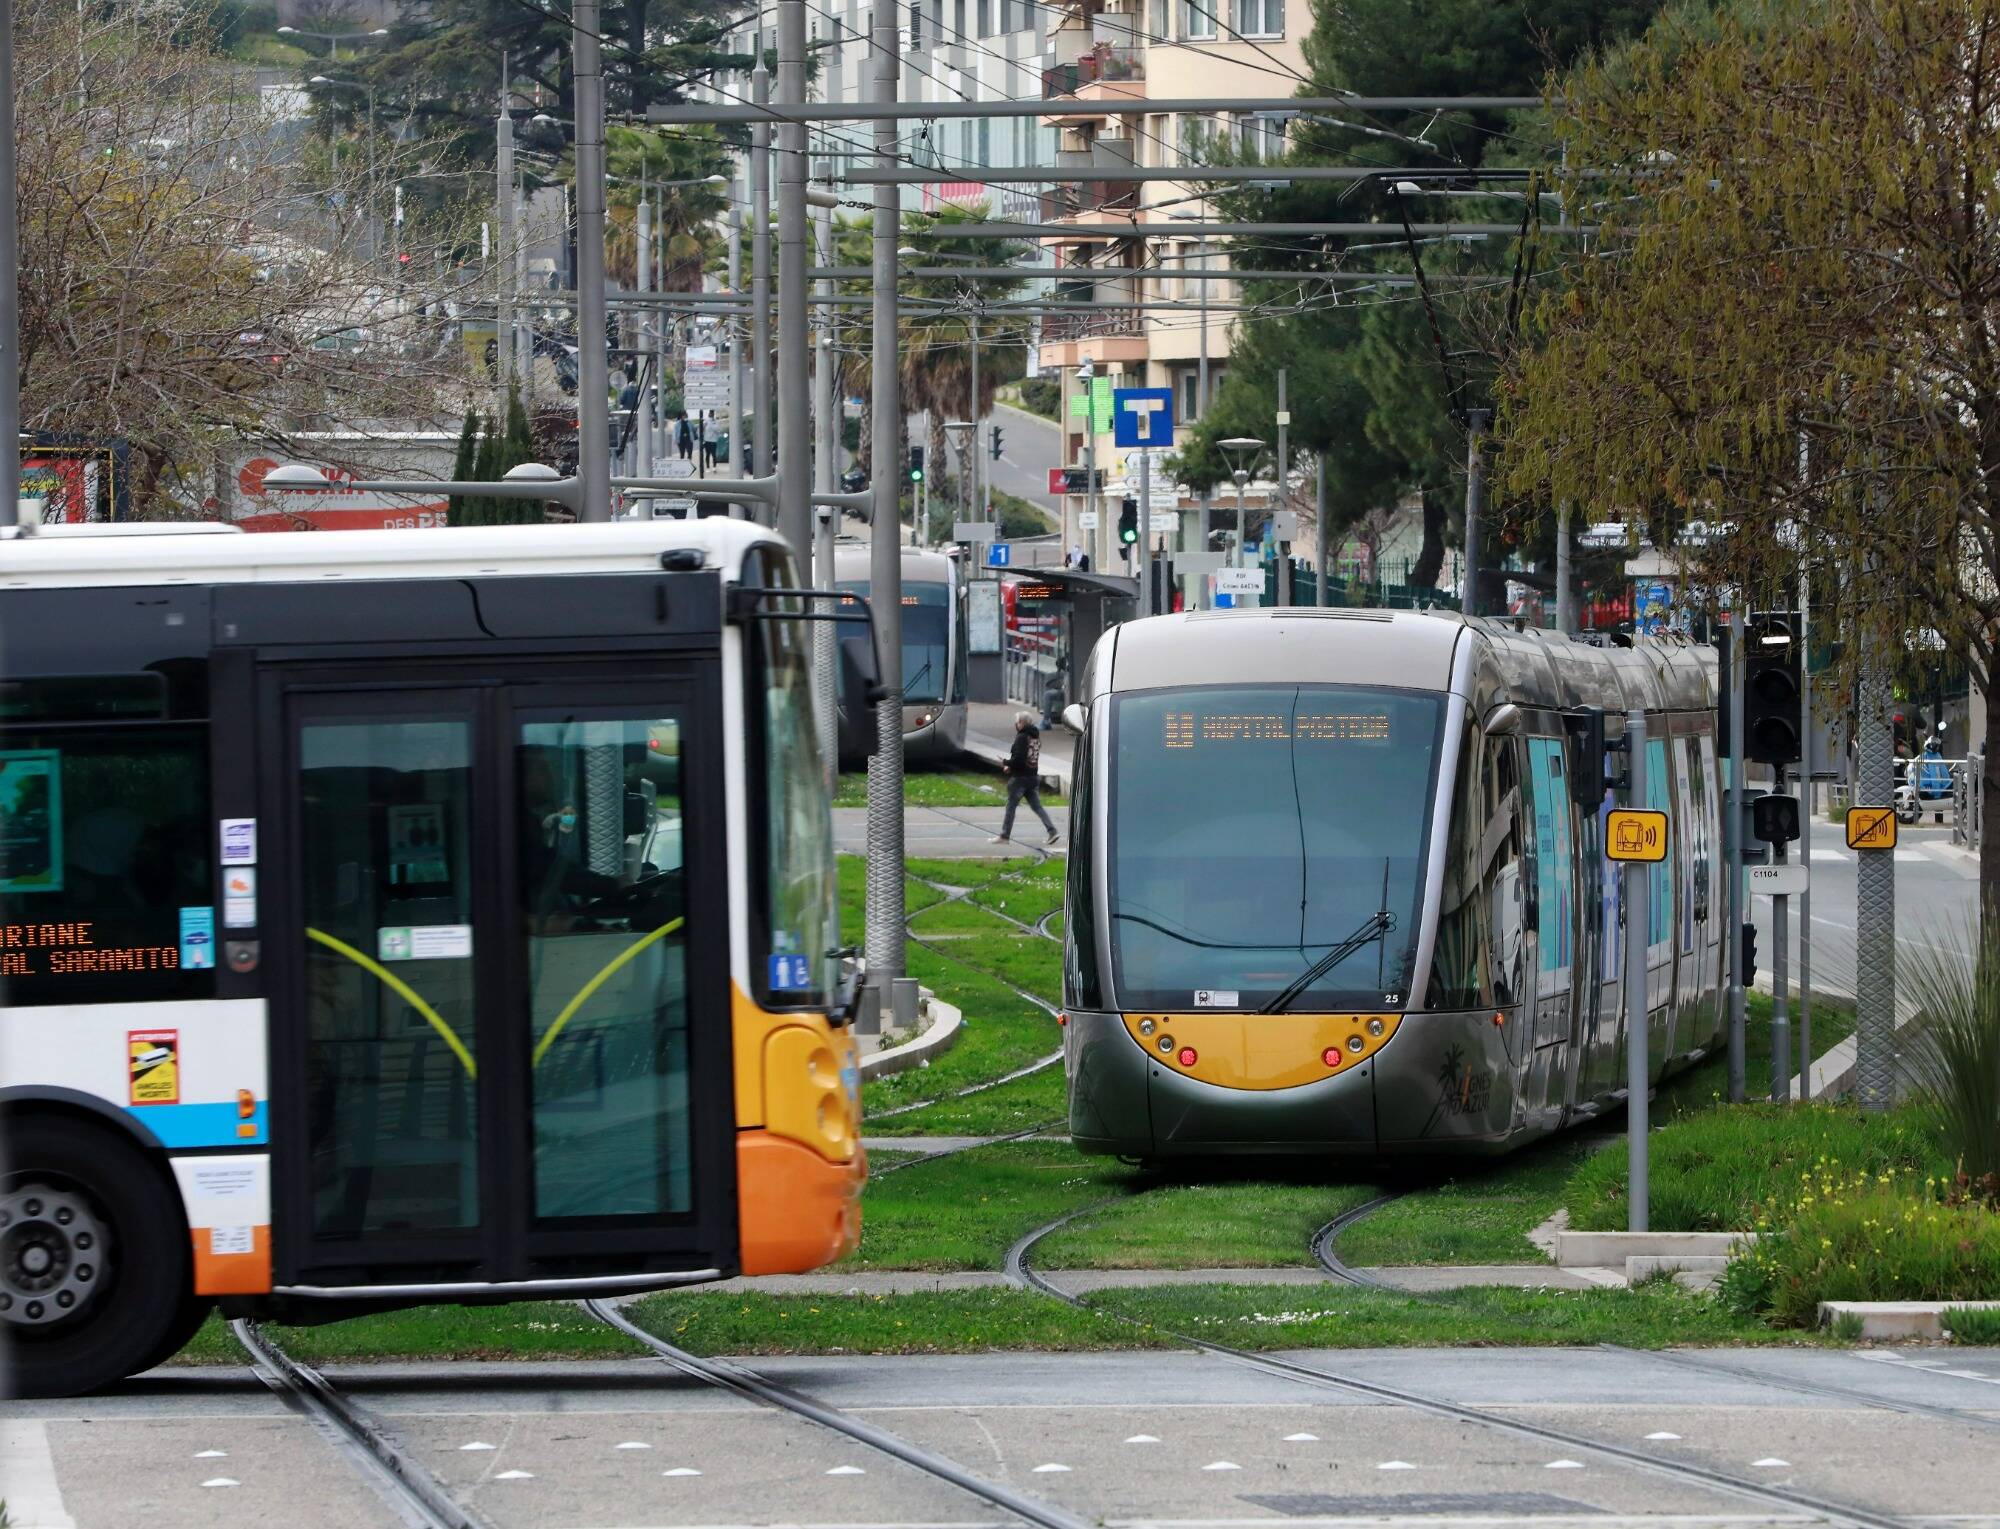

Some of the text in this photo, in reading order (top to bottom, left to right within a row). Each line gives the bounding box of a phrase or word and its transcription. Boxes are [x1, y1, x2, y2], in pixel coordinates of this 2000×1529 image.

[997, 547, 1006, 563] 1
[1753, 870, 1779, 878] C1104
[0, 922, 94, 947] RIANE
[0, 947, 178, 975] AL SARAMITO
[1385, 994, 1399, 1003] 25
